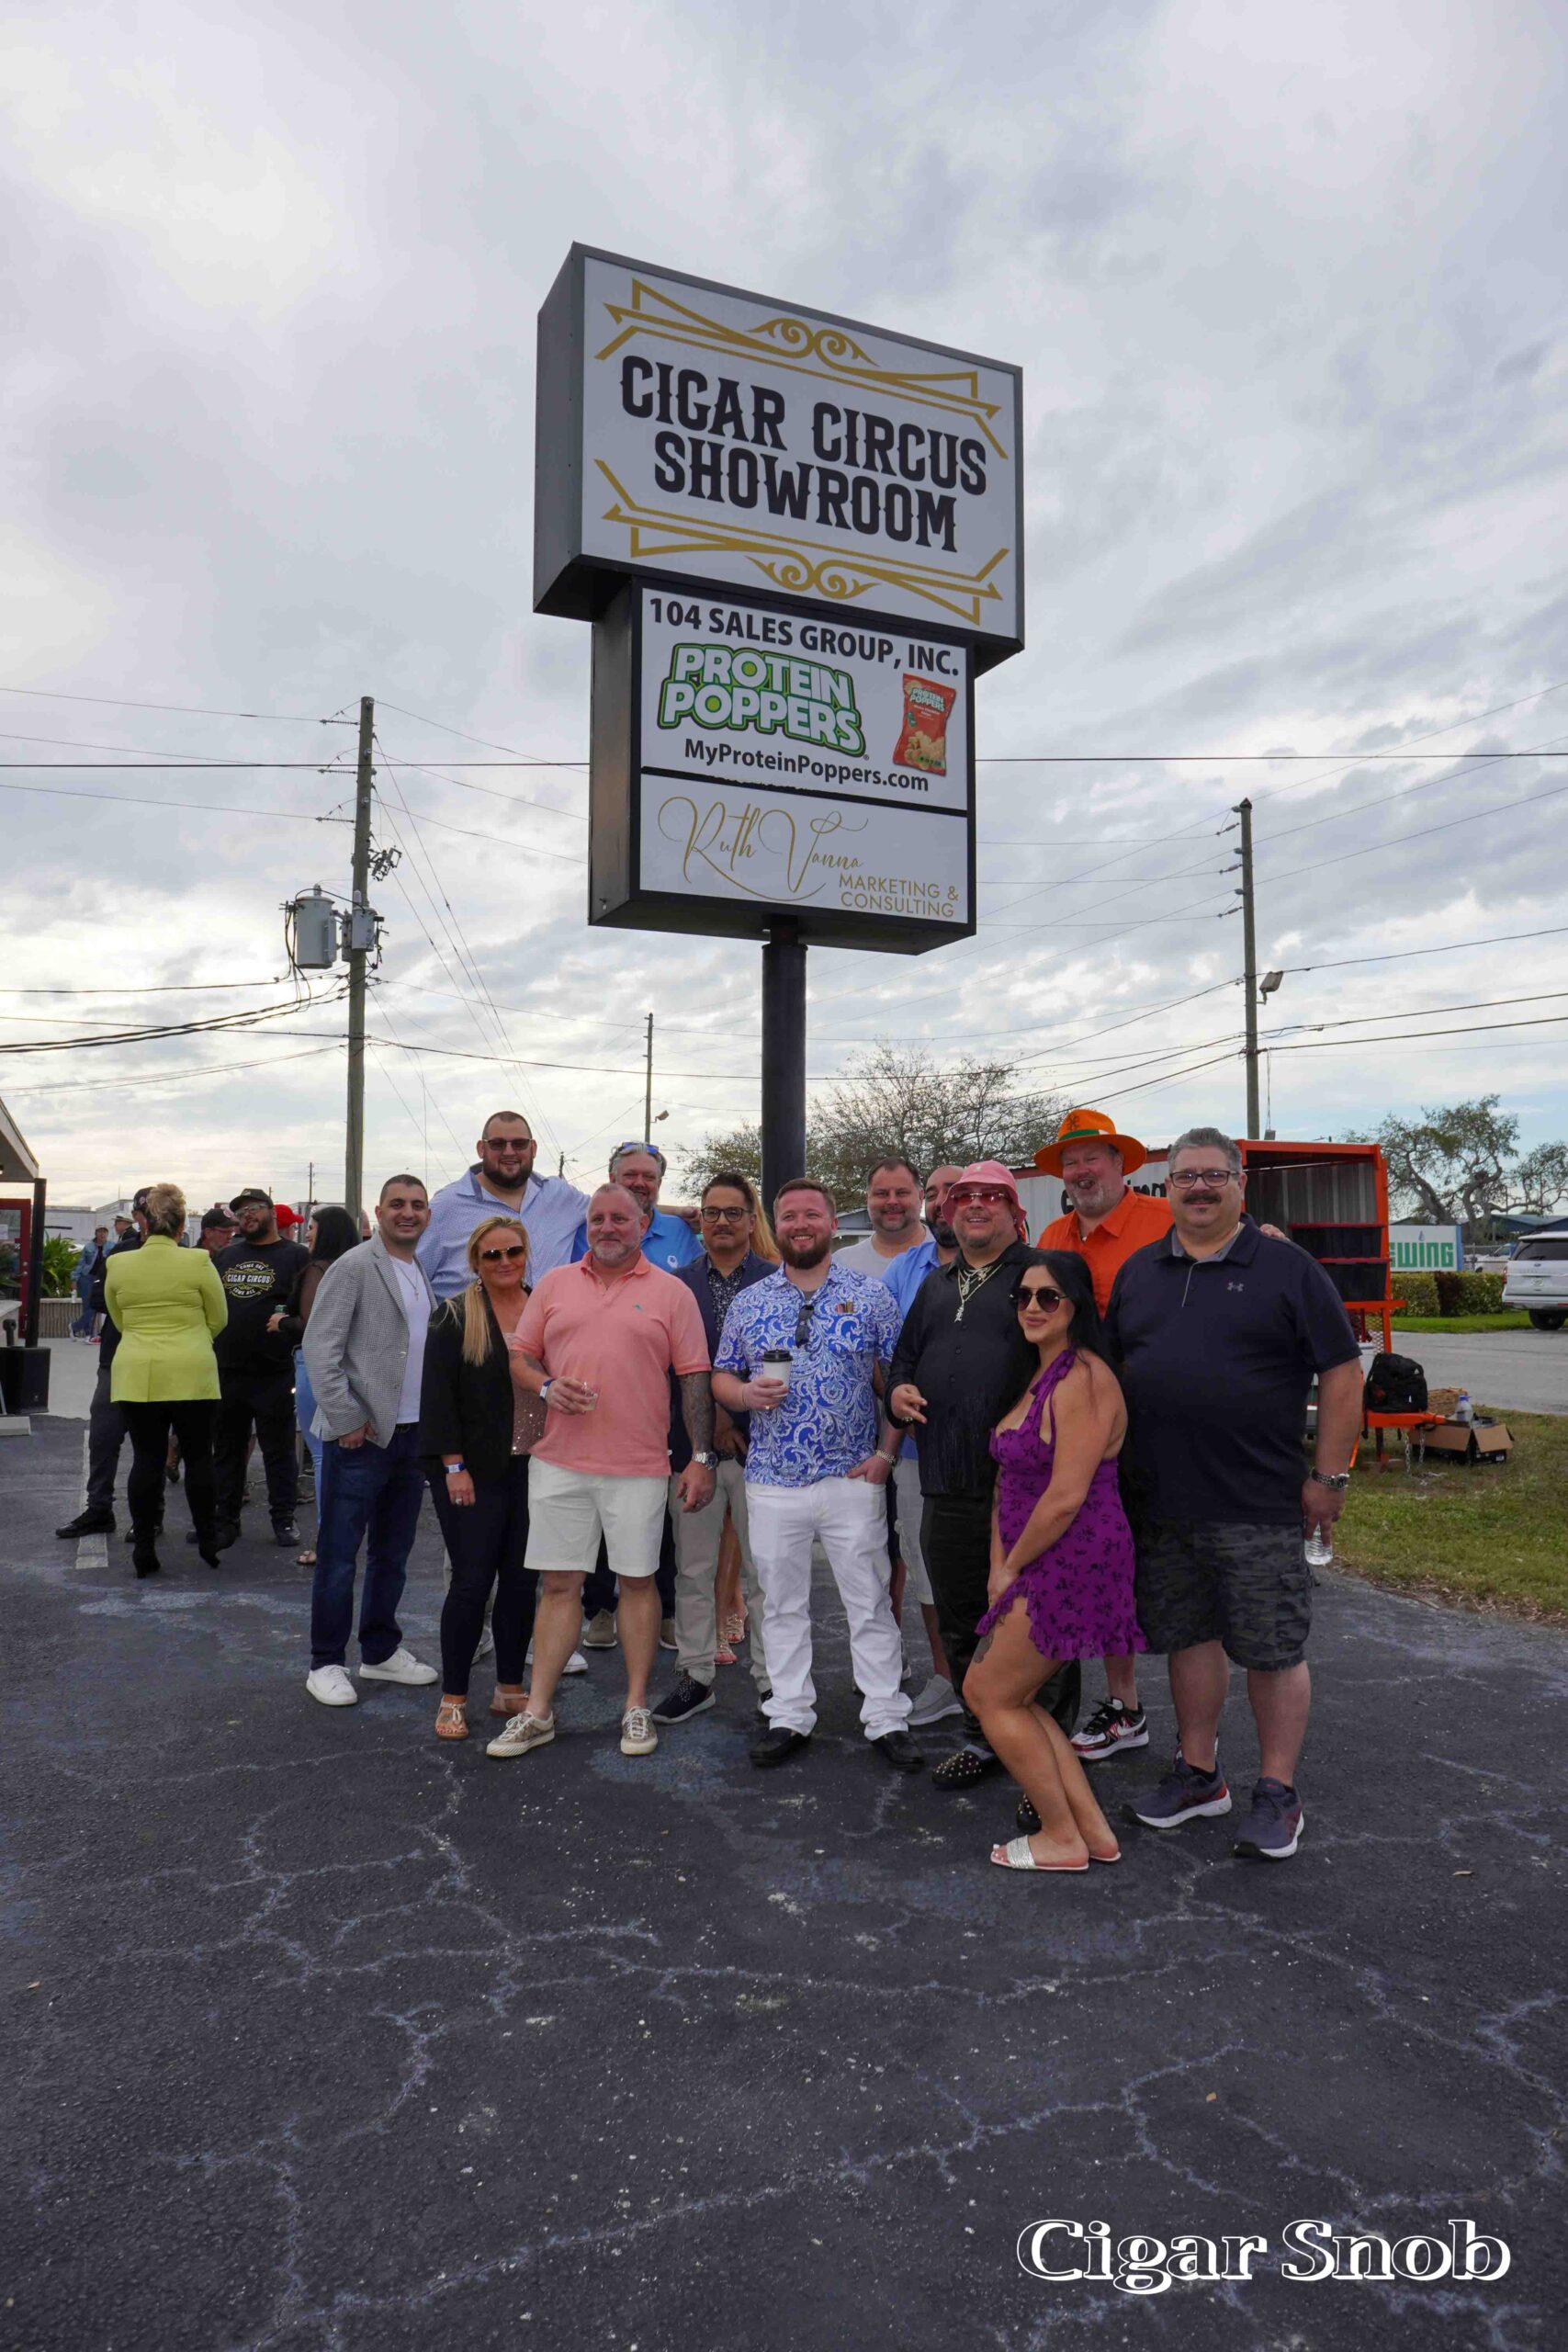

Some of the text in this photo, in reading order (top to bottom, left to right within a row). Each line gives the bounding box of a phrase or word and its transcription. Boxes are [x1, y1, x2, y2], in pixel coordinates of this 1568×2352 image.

[620, 355, 987, 496] CIGAR CIRCUS
[654, 431, 958, 553] SHOWROOM
[650, 598, 959, 676] 104 SALES GROUP, INC.
[672, 645, 852, 710] PROTEIN
[660, 682, 863, 753] POPPERS
[684, 738, 930, 791] MyProteinPoppers.com
[758, 809, 869, 893] Vanna
[839, 873, 960, 901] MARKETING &
[840, 891, 955, 918] CONSULTING
[247, 1274, 271, 1283] CIRCUS
